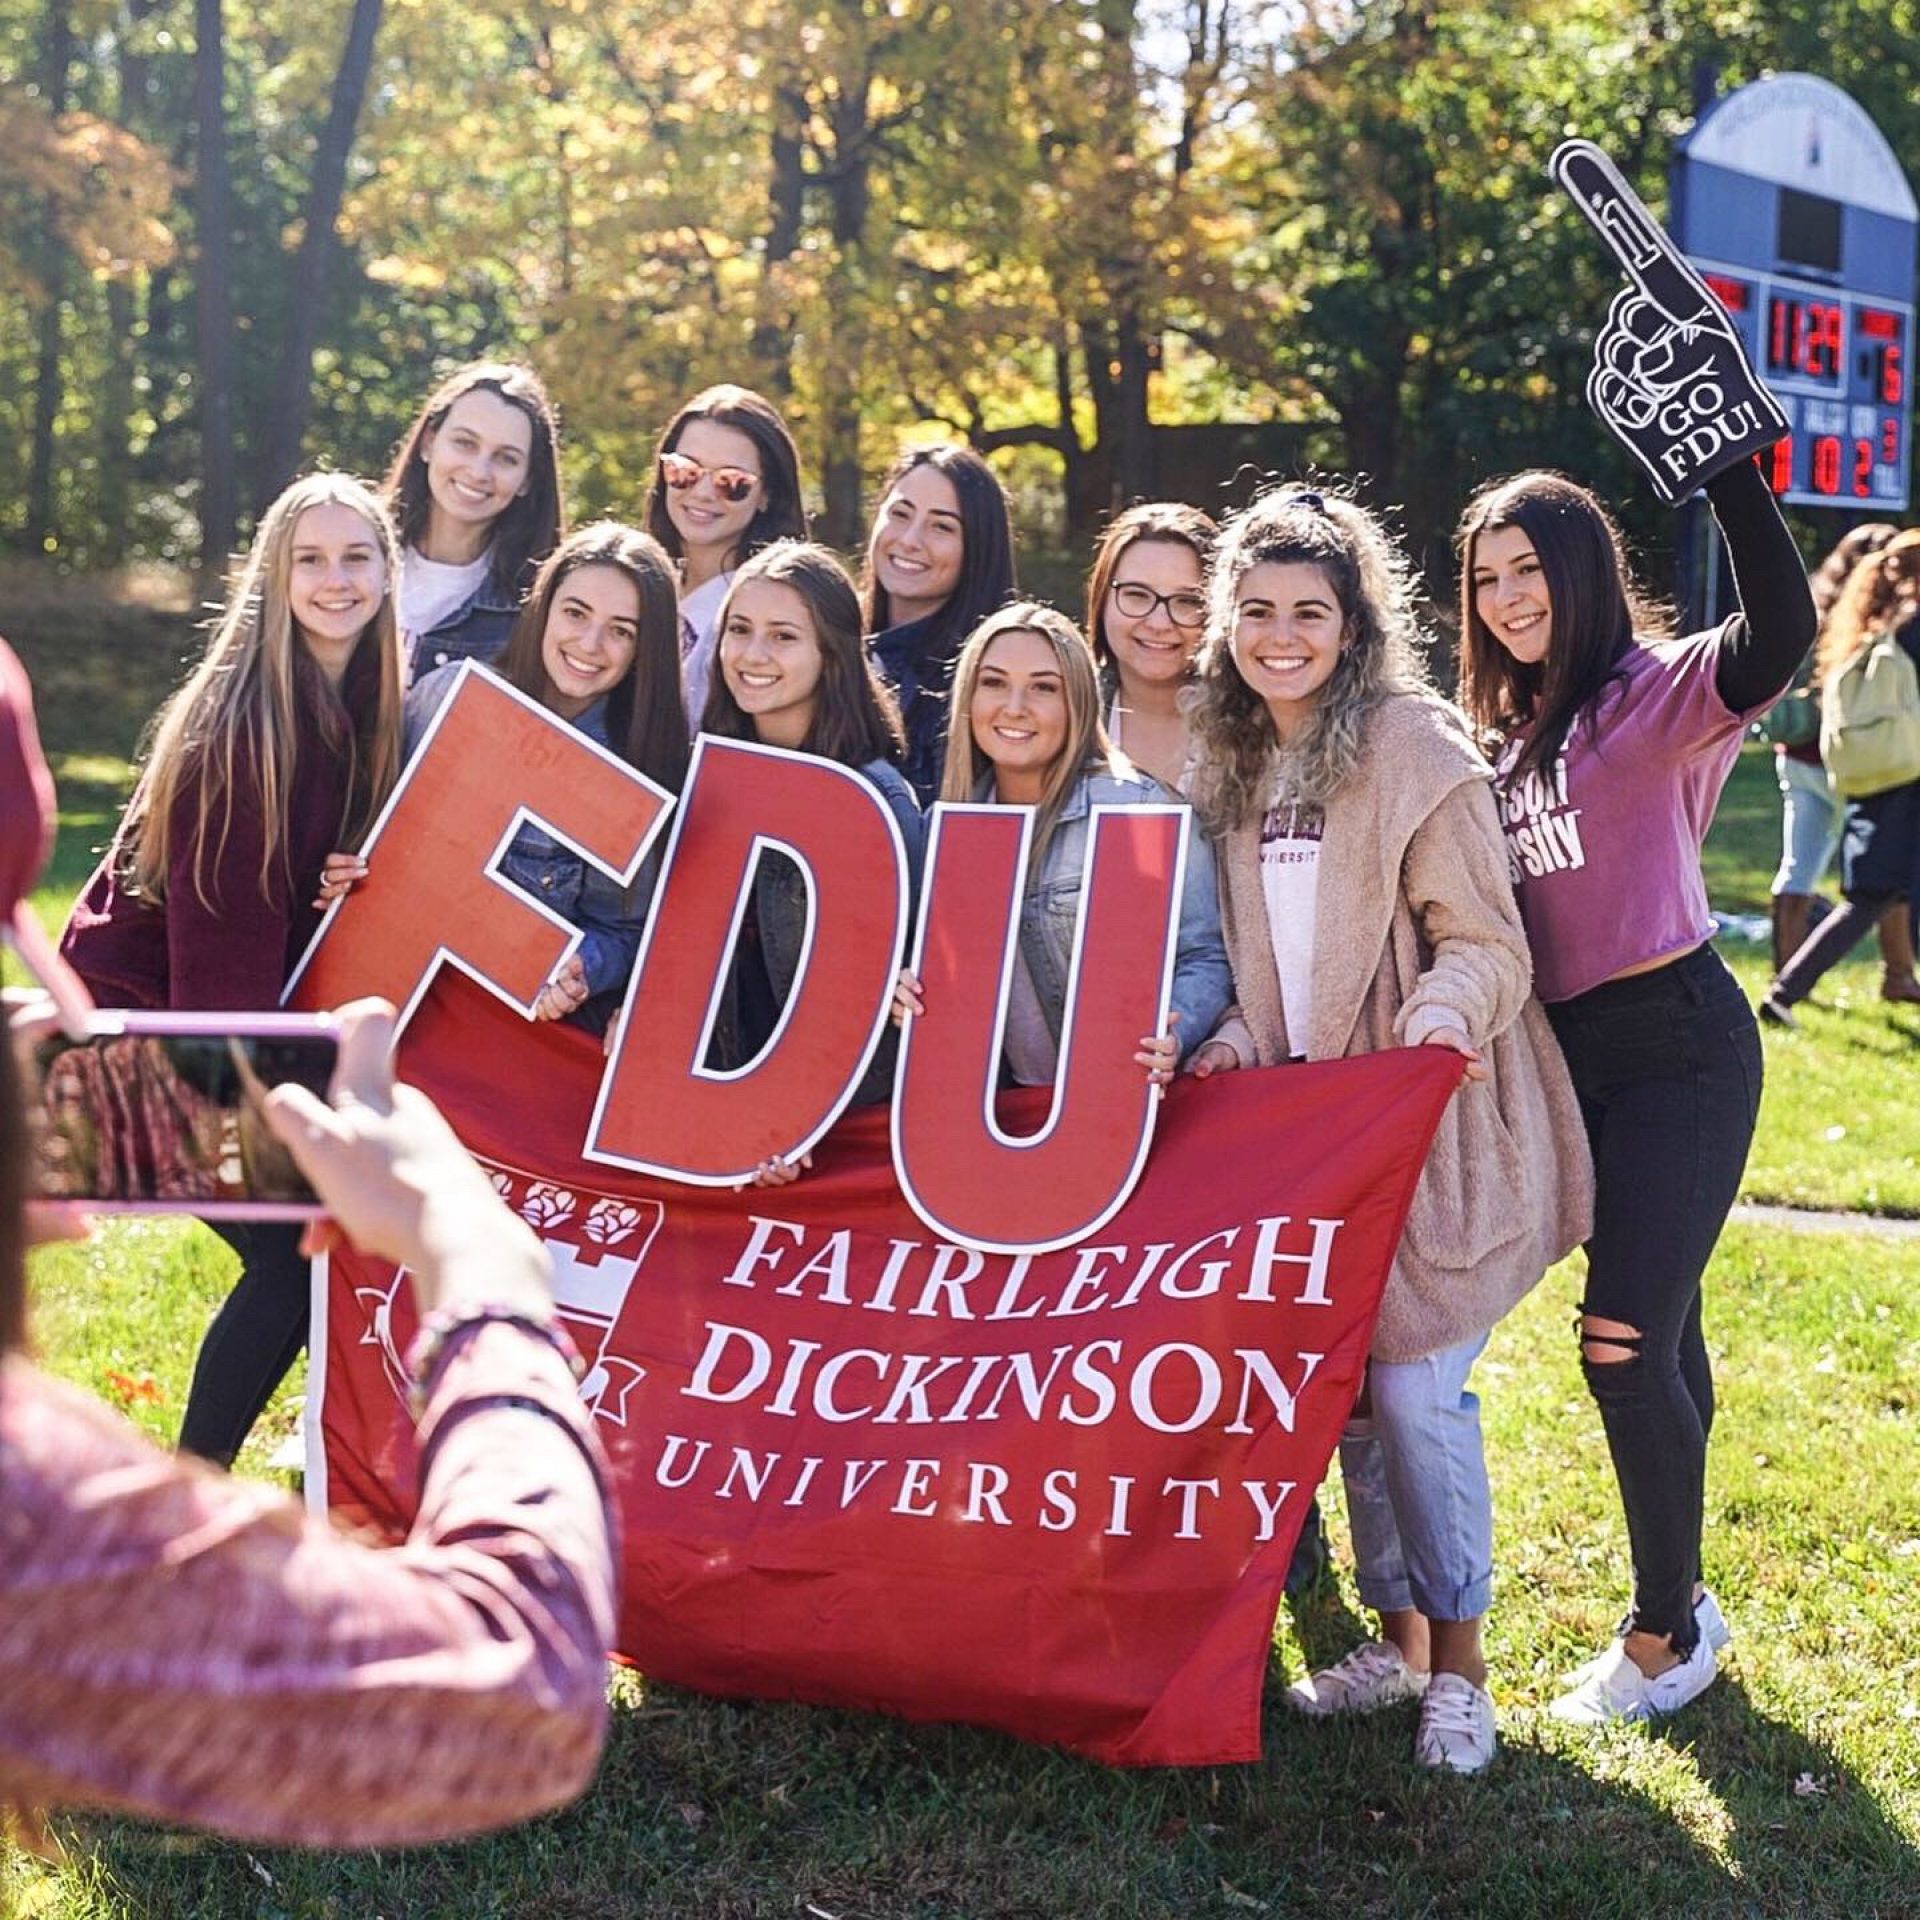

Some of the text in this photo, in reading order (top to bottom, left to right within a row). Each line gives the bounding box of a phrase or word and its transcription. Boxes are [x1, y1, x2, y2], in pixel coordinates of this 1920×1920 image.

[1659, 381, 1725, 437] GO
[1660, 400, 1763, 482] FDU!
[281, 658, 1192, 1255] FDU
[723, 1215, 1344, 1321] FAIRLEIGH
[681, 1322, 1325, 1434] DICKINSON
[655, 1435, 1297, 1541] UNIVERSITY
